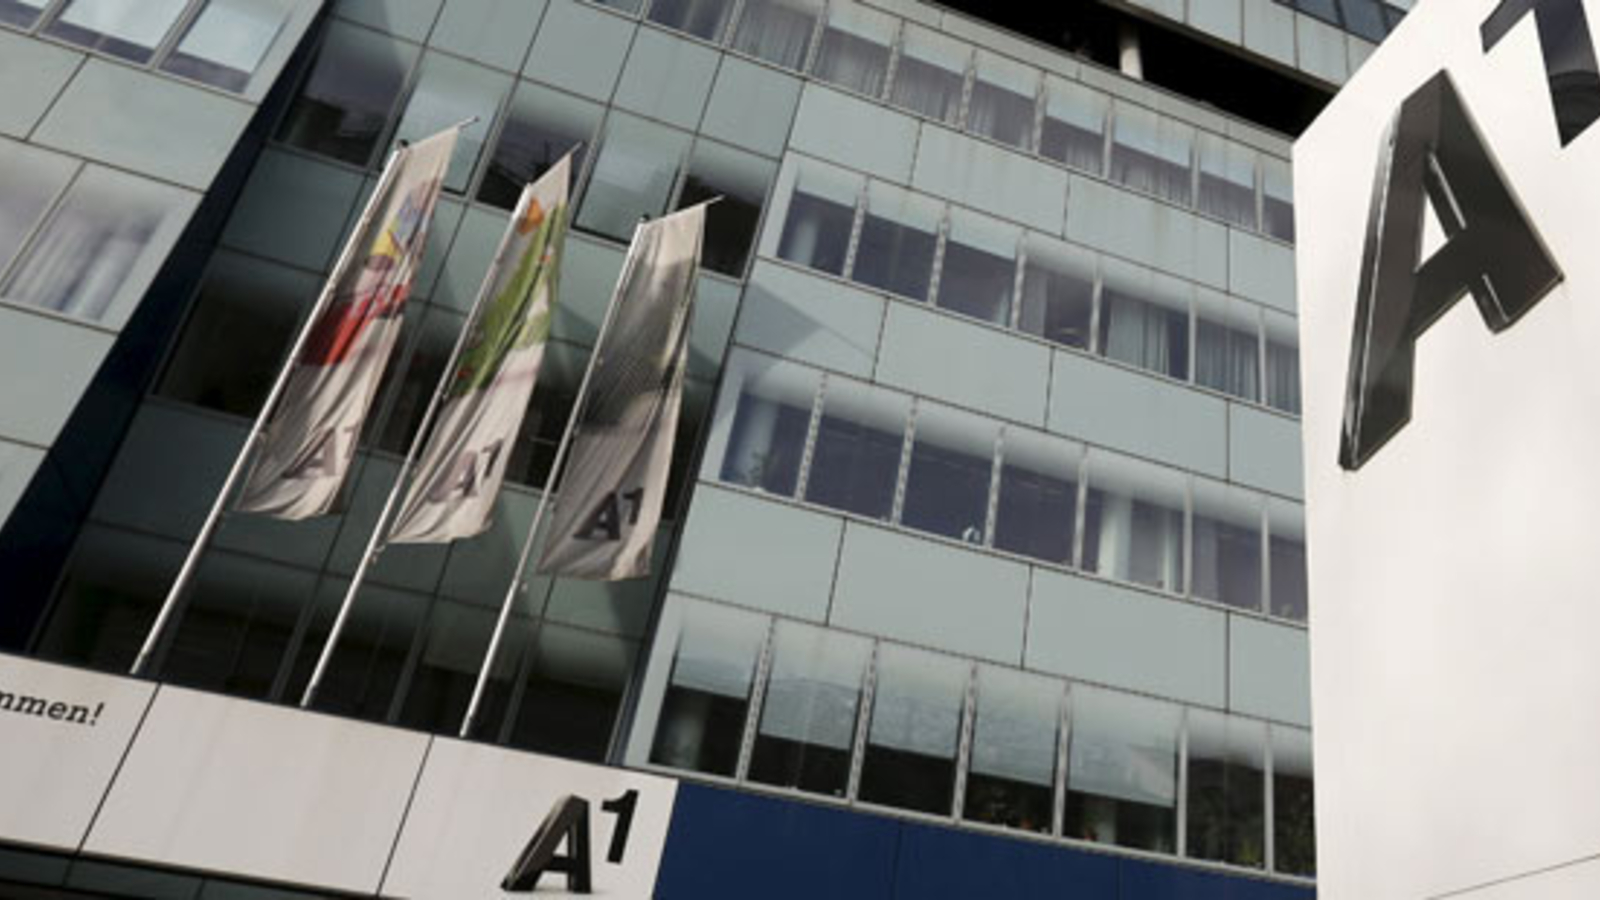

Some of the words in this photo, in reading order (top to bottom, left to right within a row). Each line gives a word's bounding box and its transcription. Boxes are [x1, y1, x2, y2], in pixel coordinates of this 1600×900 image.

[1338, 0, 1600, 471] A1
[426, 438, 504, 503] A1
[572, 487, 644, 541] A1
[500, 789, 639, 894] A1
